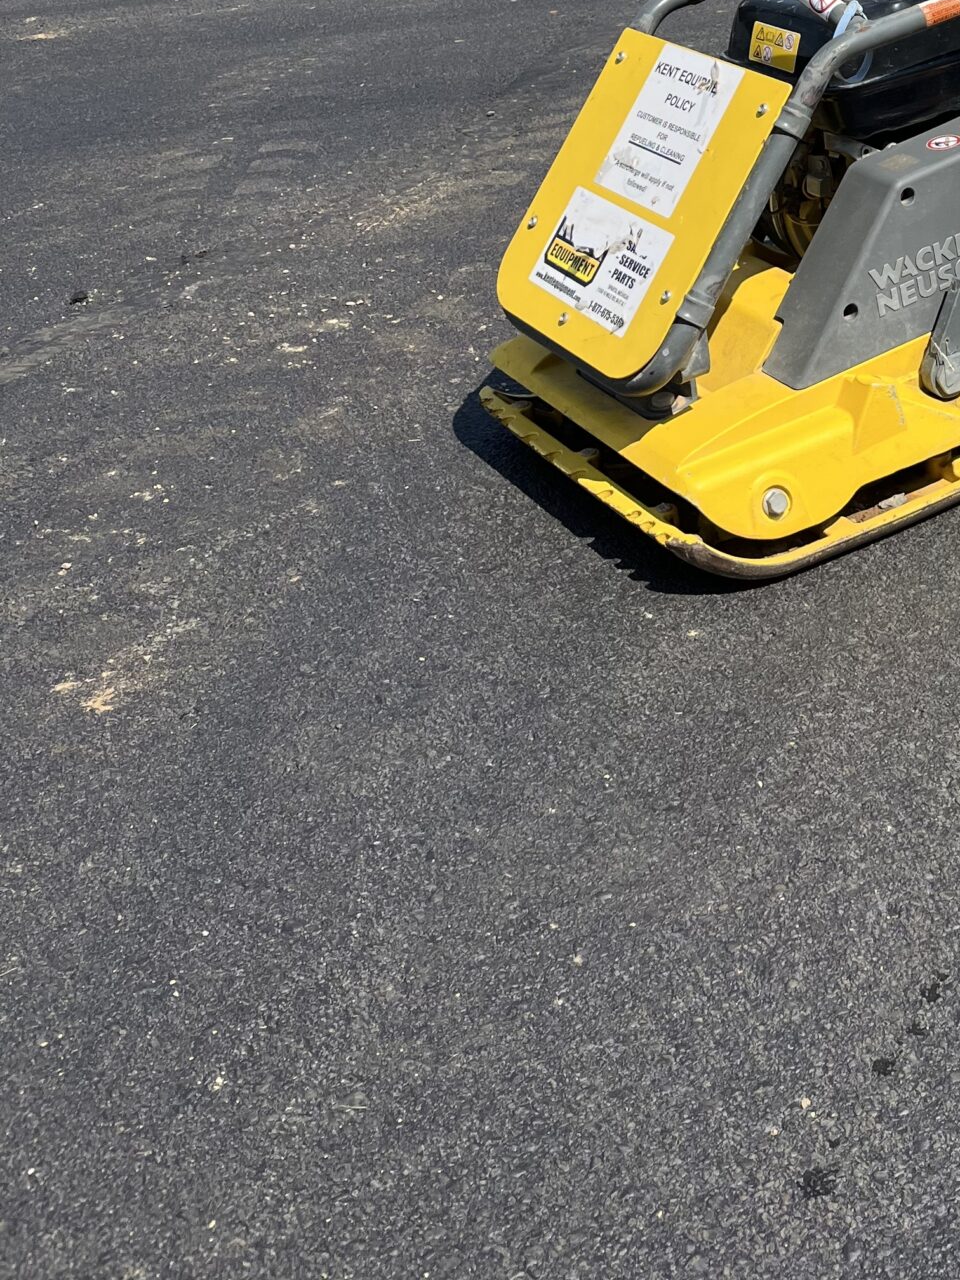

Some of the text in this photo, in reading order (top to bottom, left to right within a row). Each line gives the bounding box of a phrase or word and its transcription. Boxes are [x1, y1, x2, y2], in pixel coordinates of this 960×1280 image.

[655, 61, 680, 79] KENT
[664, 93, 696, 113] POLICY
[636, 110, 701, 142] CUSTOMER IS RESPONSIBLE
[656, 131, 668, 141] FOR
[660, 146, 685, 162] CLEANING
[550, 243, 595, 277] EQUIPMENT
[619, 254, 650, 279] SERVICE
[611, 268, 636, 289] PARTS
